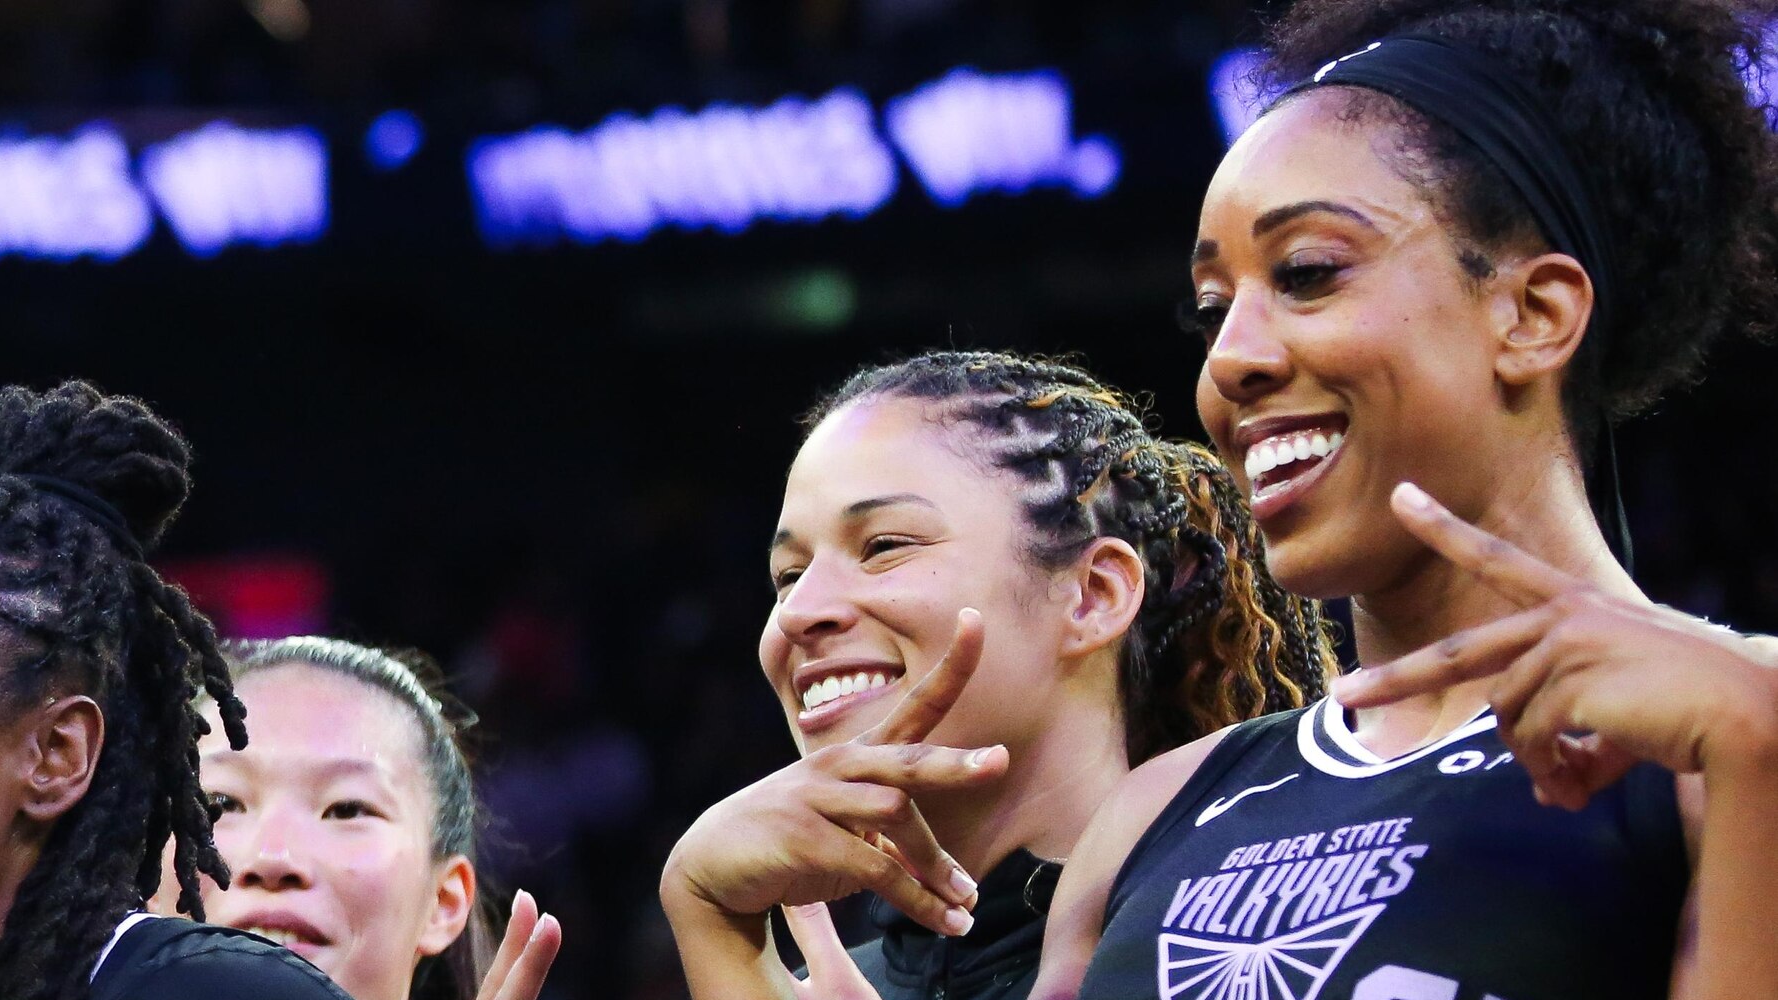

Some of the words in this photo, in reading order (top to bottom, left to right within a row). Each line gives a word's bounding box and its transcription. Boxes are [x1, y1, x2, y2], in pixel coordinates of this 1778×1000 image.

[1219, 832, 1326, 870] GOLDEN
[1325, 817, 1414, 853] STATE
[1162, 844, 1429, 938] VALKYRIES
